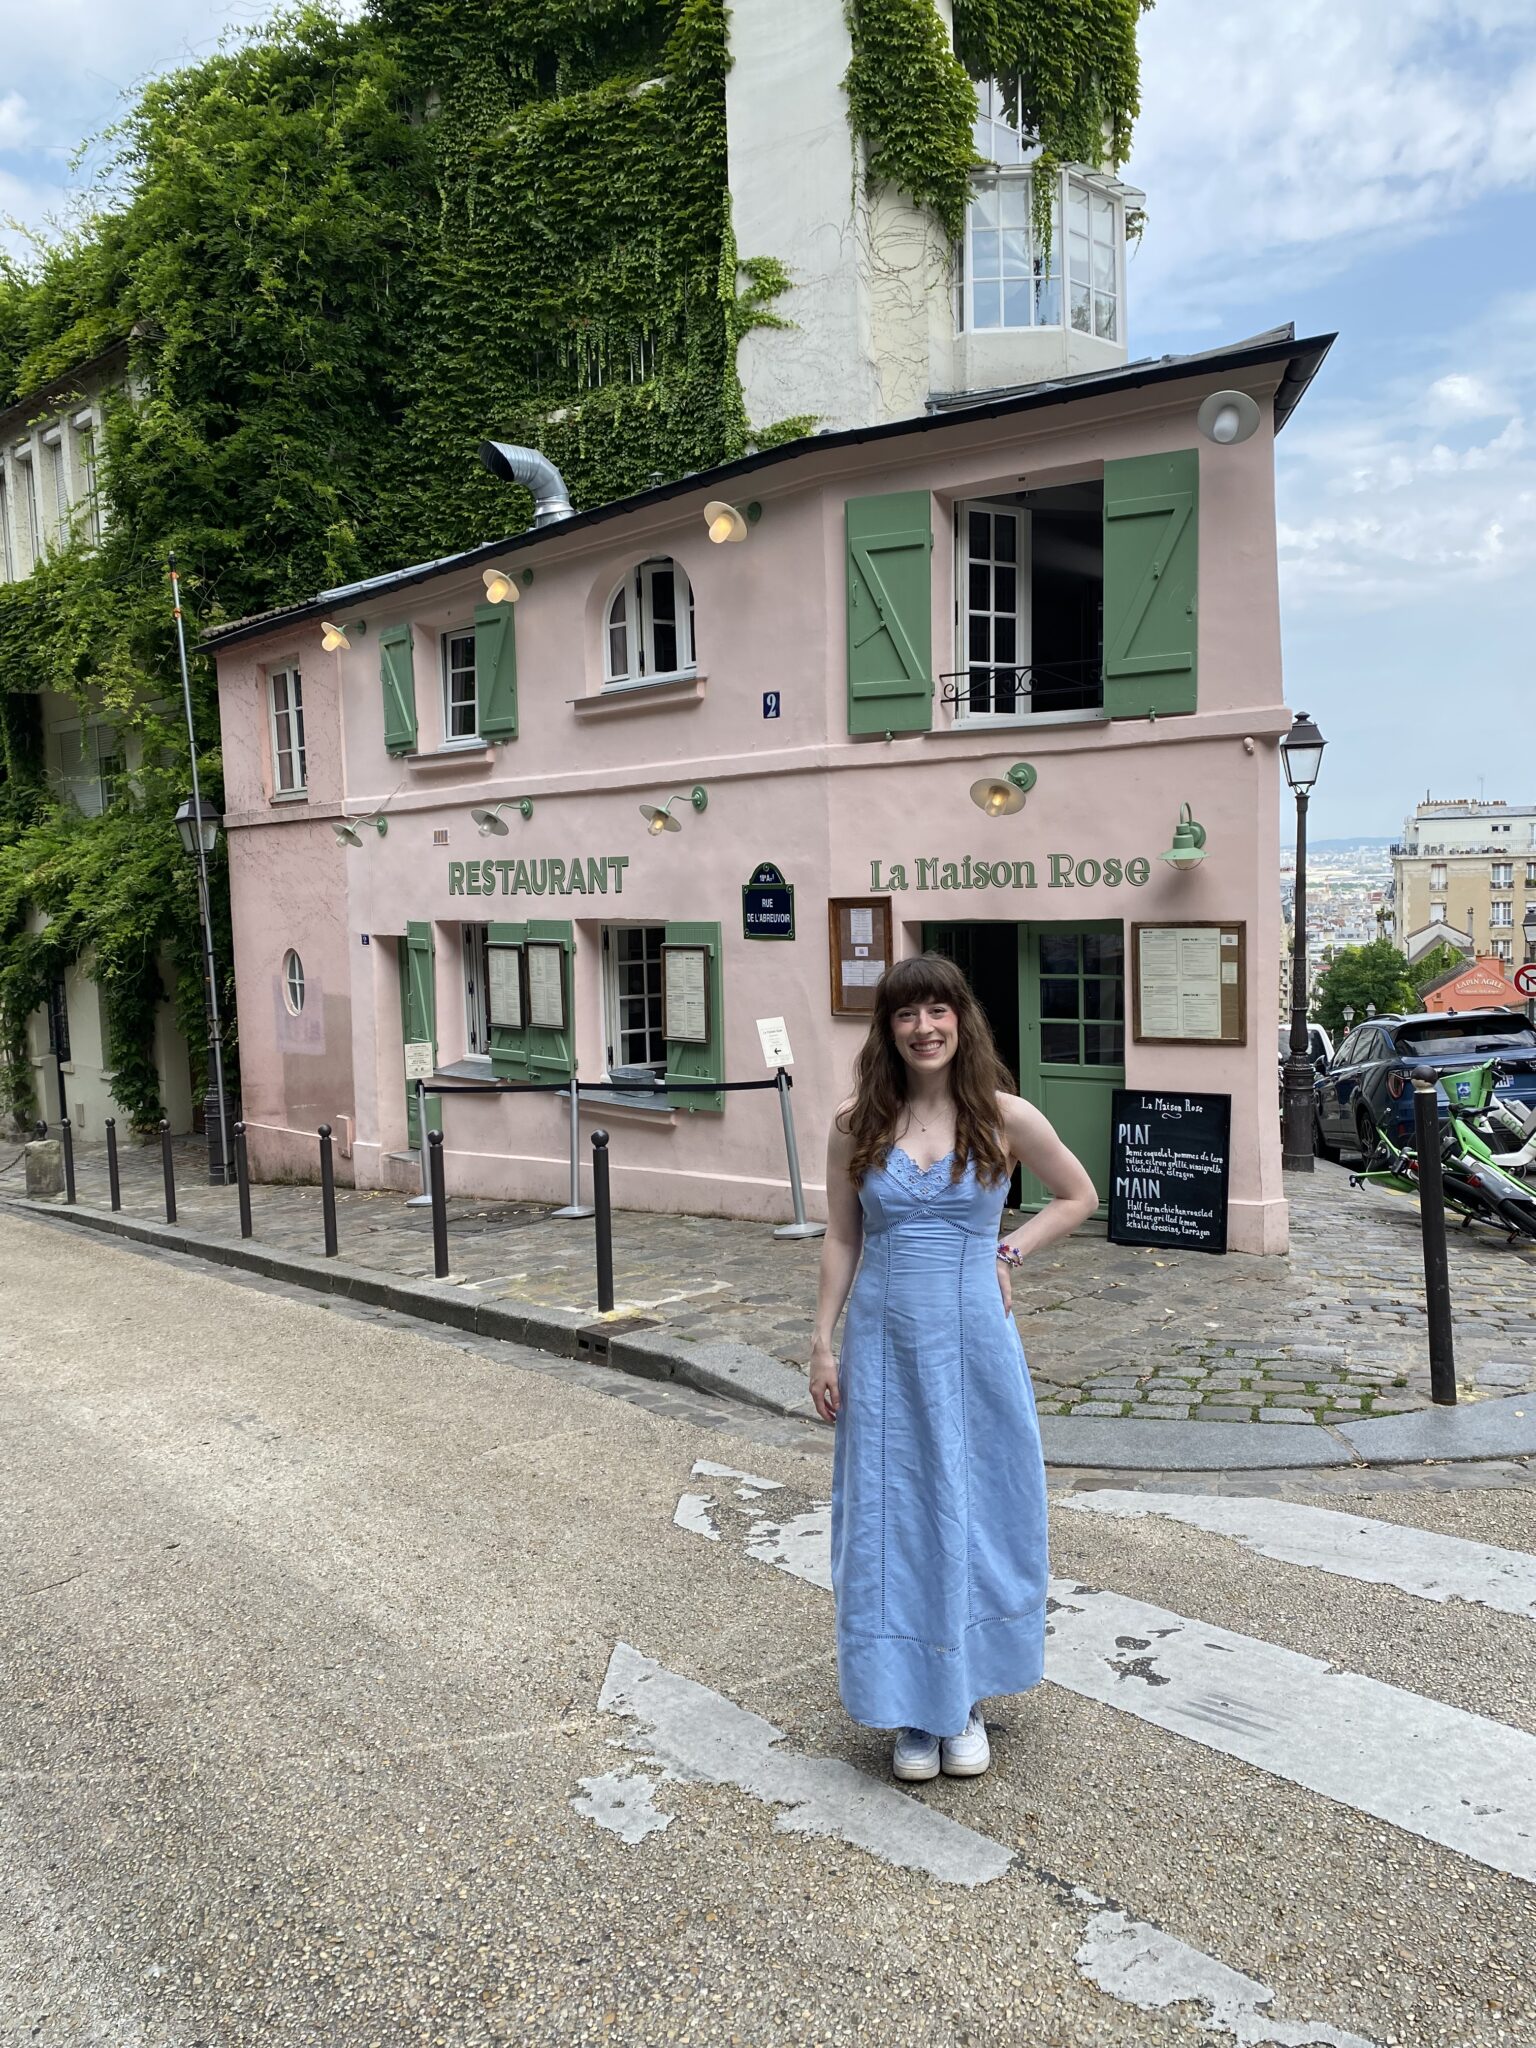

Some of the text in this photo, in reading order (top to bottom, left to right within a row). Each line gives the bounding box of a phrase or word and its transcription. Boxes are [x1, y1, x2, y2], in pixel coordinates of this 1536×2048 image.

[766, 693, 777, 718] 2
[449, 856, 629, 896] RESTAURANT
[870, 853, 1151, 892] La Maison Rose
[761, 898, 773, 908] RUE
[747, 913, 791, 923] DE L'ABREUVOIR
[1456, 978, 1503, 989] LAPIN AGILE
[1141, 1096, 1203, 1113] La Maison Rose
[1118, 1123, 1151, 1145] PLAT
[1125, 1145, 1142, 1156] Demi
[1174, 1152, 1199, 1162] pommes
[1200, 1151, 1209, 1161] de
[1145, 1158, 1167, 1167] citron
[1116, 1177, 1160, 1199] MAIN
[1127, 1199, 1143, 1211] Half
[1144, 1202, 1160, 1213] farm
[1187, 1208, 1213, 1218] roasted
[1153, 1214, 1178, 1224] grilled
[1181, 1226, 1211, 1239] tarragon
